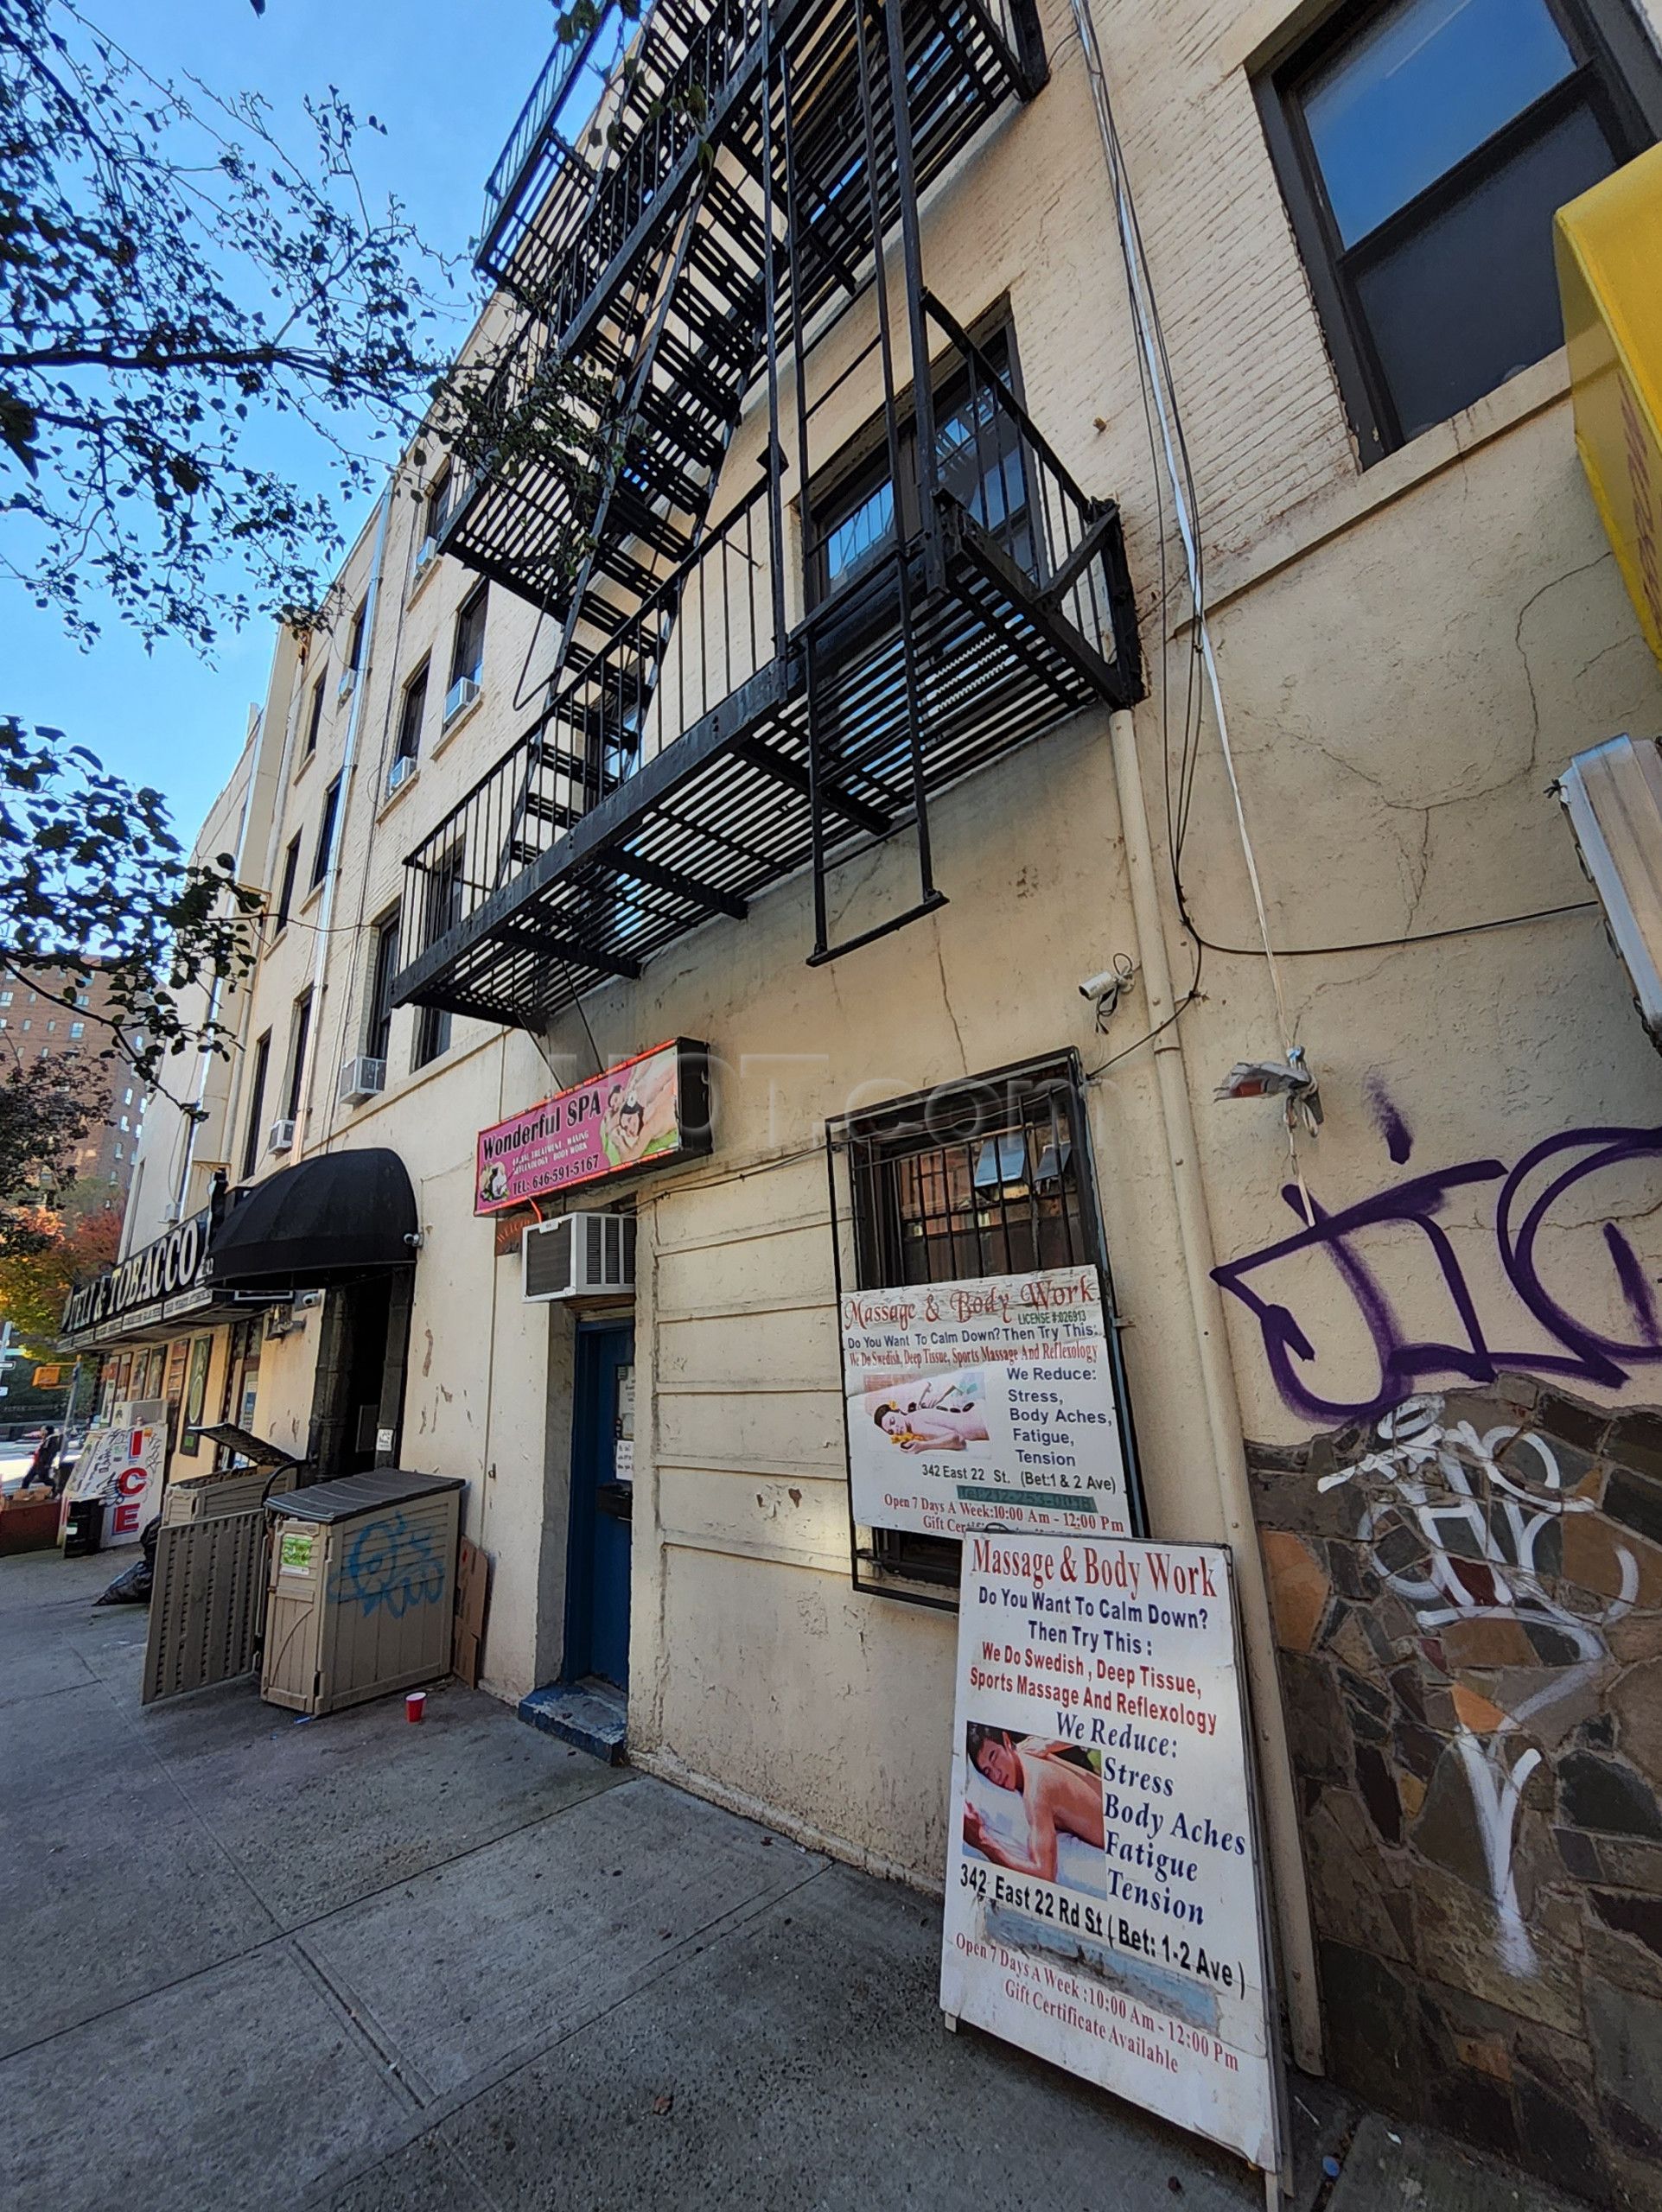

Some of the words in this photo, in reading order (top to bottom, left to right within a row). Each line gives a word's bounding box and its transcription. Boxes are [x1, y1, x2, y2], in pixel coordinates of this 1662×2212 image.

[483, 1113, 560, 1160] Wonderful
[566, 1090, 602, 1127] SPA
[513, 1179, 530, 1196] TEL:
[532, 1154, 599, 1189] 646-591-5167
[106, 1218, 199, 1315] TOBACCO
[844, 1297, 916, 1331] Massage
[926, 1294, 941, 1322] &
[951, 1287, 1012, 1324] Body
[1020, 1274, 1098, 1312] Work
[1018, 1312, 1050, 1325] LICENSE
[848, 1337, 861, 1350] Do
[863, 1336, 882, 1348] You
[884, 1334, 909, 1347] Want
[915, 1333, 927, 1345] To
[931, 1332, 958, 1344] Calm
[962, 1327, 1000, 1343] Down?
[1003, 1328, 1035, 1341] Then
[1038, 1325, 1059, 1341] Try
[1063, 1323, 1098, 1338] This:
[850, 1352, 860, 1367] We
[861, 1351, 871, 1365] Do
[904, 1349, 921, 1369] Deep
[923, 1348, 951, 1365] Tissue,
[952, 1347, 979, 1368] Sports
[980, 1345, 1018, 1365] Massage
[1022, 1343, 1040, 1361] And
[1042, 1340, 1098, 1363] Reflexology
[1006, 1368, 1029, 1381] We
[1033, 1367, 1097, 1381] Reduce:
[1008, 1389, 1064, 1405] Stress,
[1009, 1408, 1049, 1425] Body
[1055, 1409, 1112, 1427] Aches,
[1013, 1428, 1075, 1446] Fatigue,
[1016, 1449, 1076, 1467] Tension
[113, 1428, 148, 1536] ICE
[921, 1464, 940, 1478] 342
[942, 1466, 967, 1479] East
[971, 1467, 985, 1481] 22
[994, 1470, 1011, 1484] St.
[1060, 1475, 1071, 1488] &
[1073, 1476, 1083, 1489] 2
[1086, 1476, 1117, 1495] Ave)
[884, 1494, 910, 1510] Open
[912, 1497, 920, 1510] 7
[921, 1497, 945, 1515] Days
[947, 1500, 957, 1512] A
[1028, 1509, 1050, 1525] Am
[1063, 1512, 1096, 1529] 12:00
[1100, 1516, 1124, 1533] Pm
[923, 1516, 946, 1531] Gift
[971, 1538, 1054, 1589] Massage
[1060, 1545, 1079, 1583] &
[1084, 1547, 1141, 1600] Body
[1144, 1551, 1218, 1598] Work
[979, 1586, 997, 1605] Do
[1002, 1589, 1028, 1609] You
[1031, 1591, 1071, 1614] Want
[1075, 1596, 1095, 1618] To
[1099, 1598, 1143, 1624] Calm
[1149, 1605, 1208, 1630] Down?
[1028, 1620, 1067, 1644] Then
[1072, 1625, 1099, 1653] Try
[982, 1642, 1001, 1662] We
[1004, 1646, 1022, 1666] Do
[1097, 1659, 1136, 1688] Deep
[1140, 1665, 1202, 1700] Tissue,
[971, 1667, 1013, 1693] Sports
[1017, 1675, 1079, 1708] Massage
[1083, 1686, 1112, 1711] And
[1117, 1693, 1217, 1736] Reflexology
[1056, 1712, 1086, 1740] We
[1091, 1717, 1178, 1758] Reduce:
[1104, 1756, 1175, 1797] Stress
[1105, 1793, 1164, 1839] Body
[1170, 1812, 1245, 1856] Aches
[1105, 1830, 1198, 1883] Fatigue
[960, 1864, 988, 1895] 342
[995, 1875, 1031, 1910] East
[1035, 1889, 1054, 1918] 22
[1059, 1897, 1080, 1928] Rd
[1085, 1906, 1103, 1938] St
[1162, 1935, 1192, 1972] 1-2
[1107, 1868, 1205, 1926] Tension
[956, 1932, 987, 1960] Open
[990, 1945, 997, 1962] 7
[1000, 1949, 1030, 1982] Days
[1031, 1965, 1041, 1985] A
[1130, 2005, 1156, 2032] Am
[1168, 2020, 1210, 2058] 12:00
[1213, 2037, 1239, 2072] Pm
[1005, 1978, 1030, 2006] Gift
[1033, 1993, 1106, 2041] Certificate
[1109, 2027, 1179, 2074] Available
